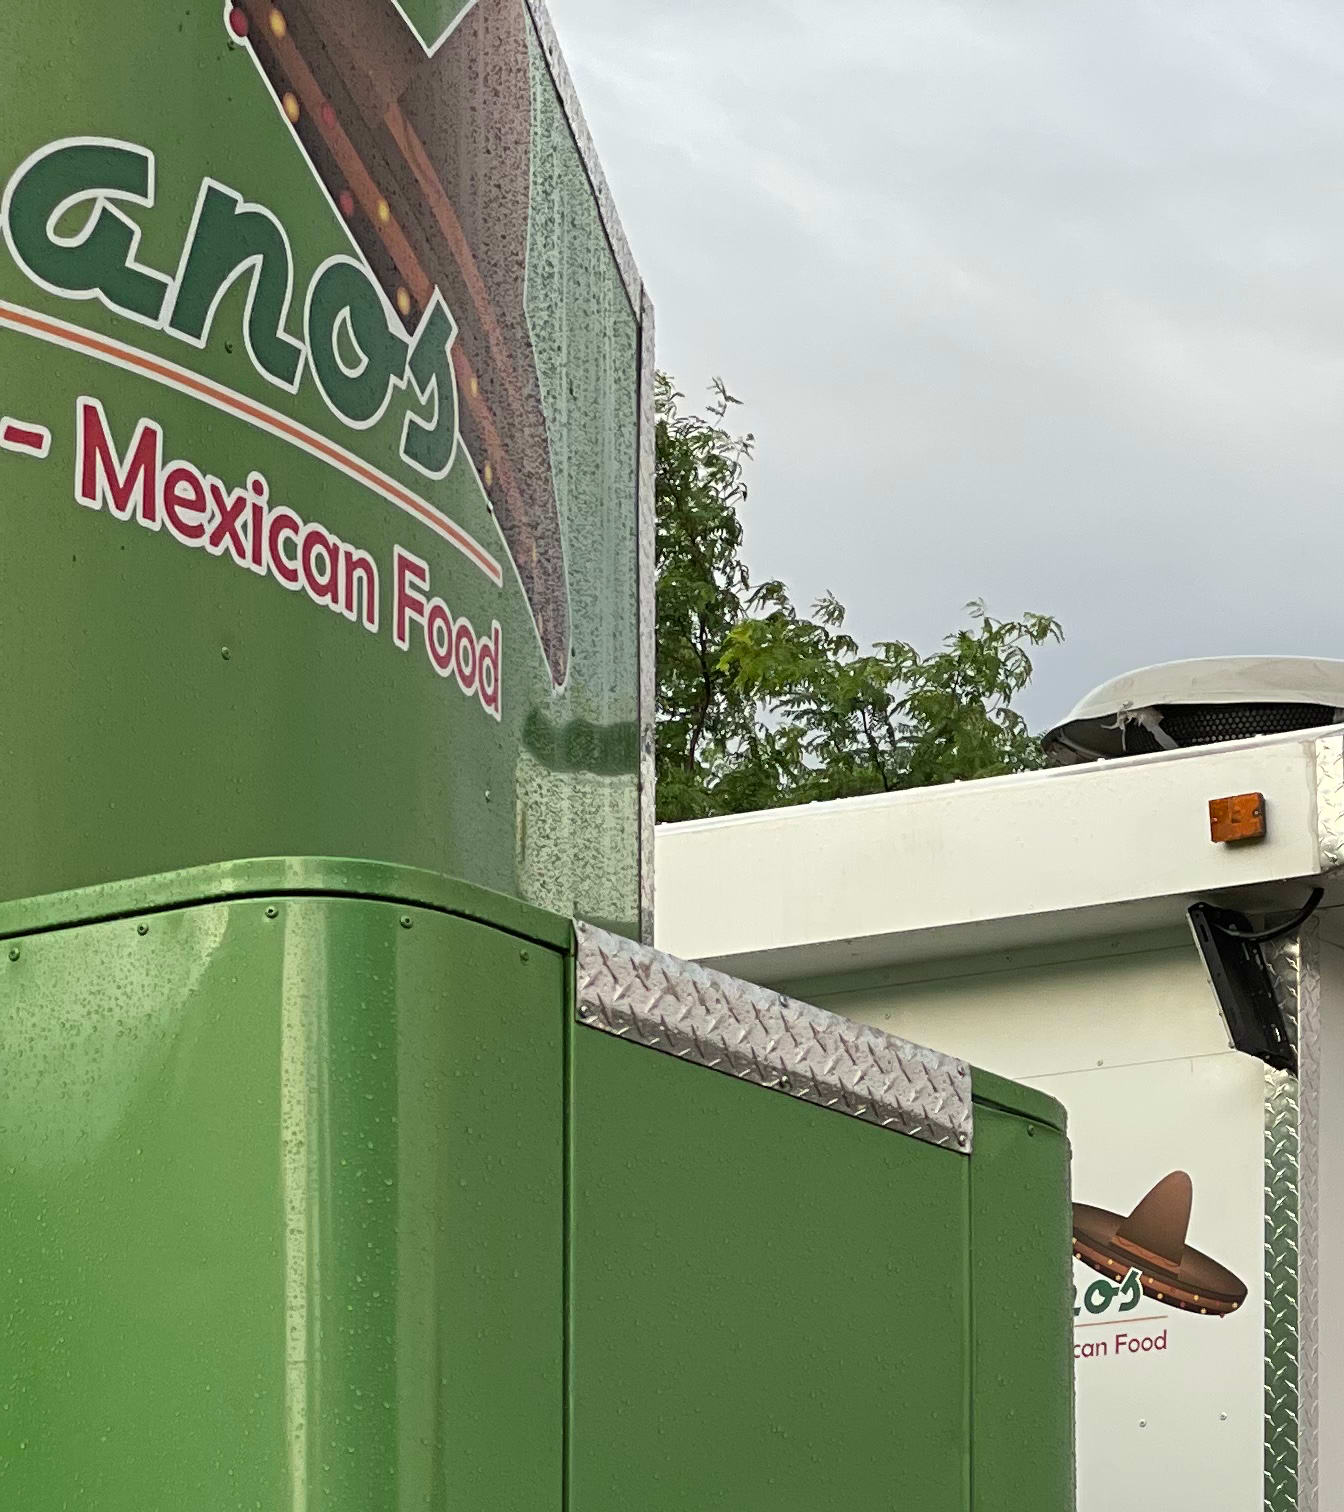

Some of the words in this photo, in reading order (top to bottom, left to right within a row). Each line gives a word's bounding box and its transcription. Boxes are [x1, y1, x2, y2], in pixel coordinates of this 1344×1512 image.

[80, 400, 378, 631] Mexican
[395, 549, 500, 717] Food
[1072, 1270, 1142, 1317] os
[1115, 1329, 1168, 1355] Food
